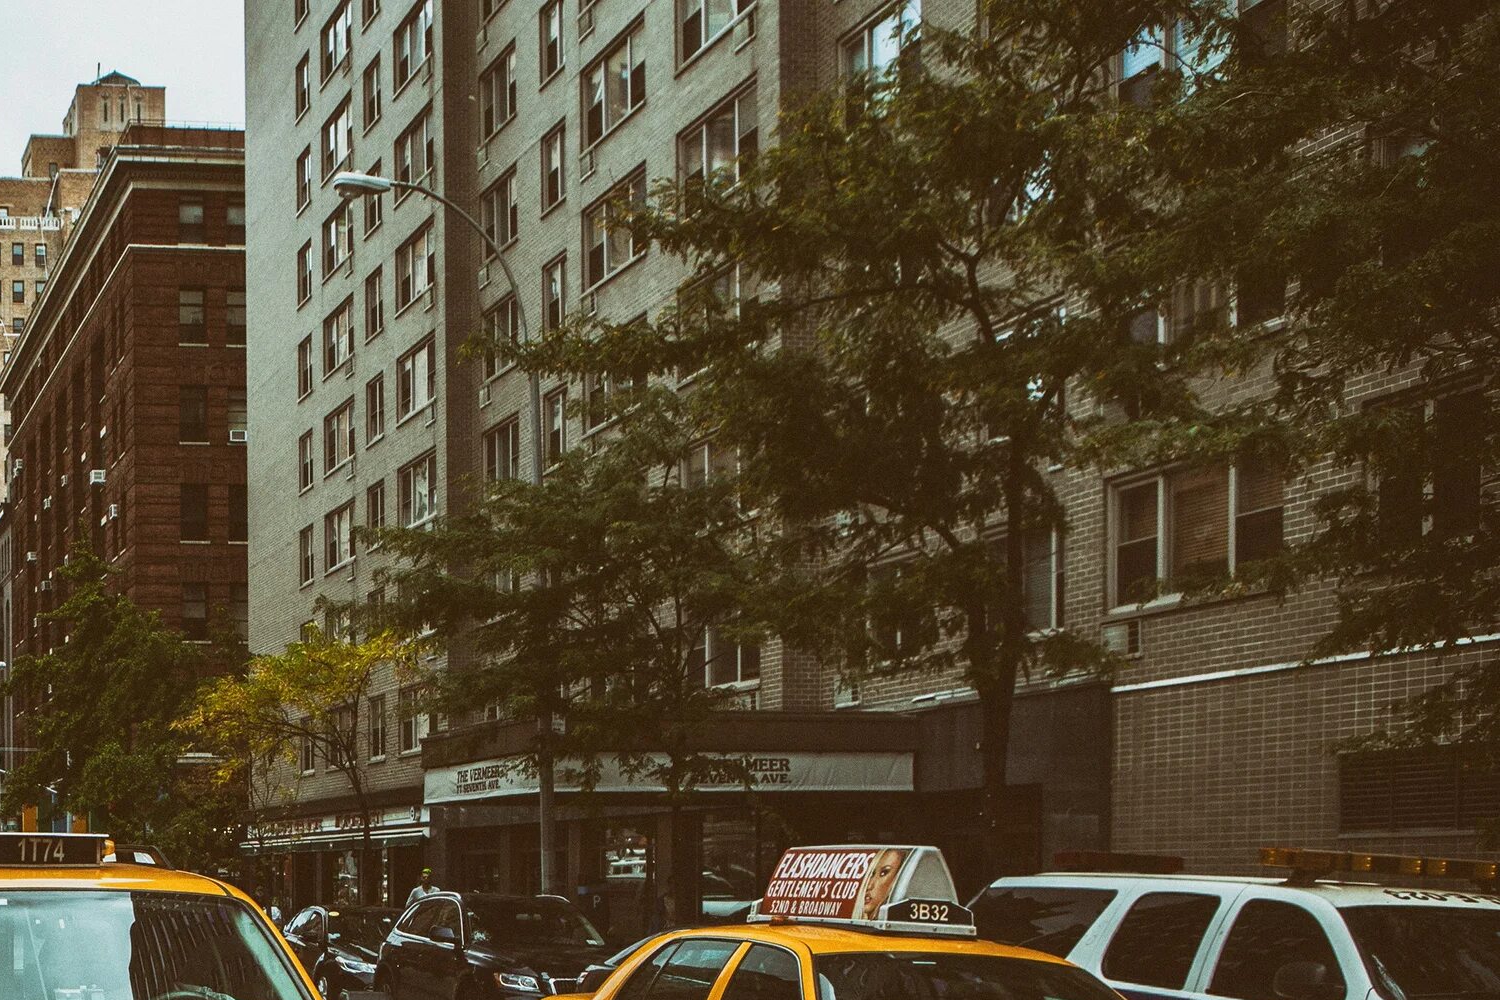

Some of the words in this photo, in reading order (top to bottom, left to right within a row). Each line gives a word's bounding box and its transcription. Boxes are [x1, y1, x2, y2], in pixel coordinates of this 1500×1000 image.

[457, 769, 469, 784] THE
[760, 773, 792, 784] AVE.
[487, 780, 501, 791] AVE.
[18, 838, 65, 862] 1T74
[775, 852, 876, 879] FLASHDANCERS
[767, 880, 832, 898] GENTLEMEN'S
[830, 881, 860, 900] CLUB
[770, 900, 790, 914] 52ND
[790, 901, 797, 914] &
[798, 901, 842, 917] BROADWAY
[910, 903, 949, 921] 3B32
